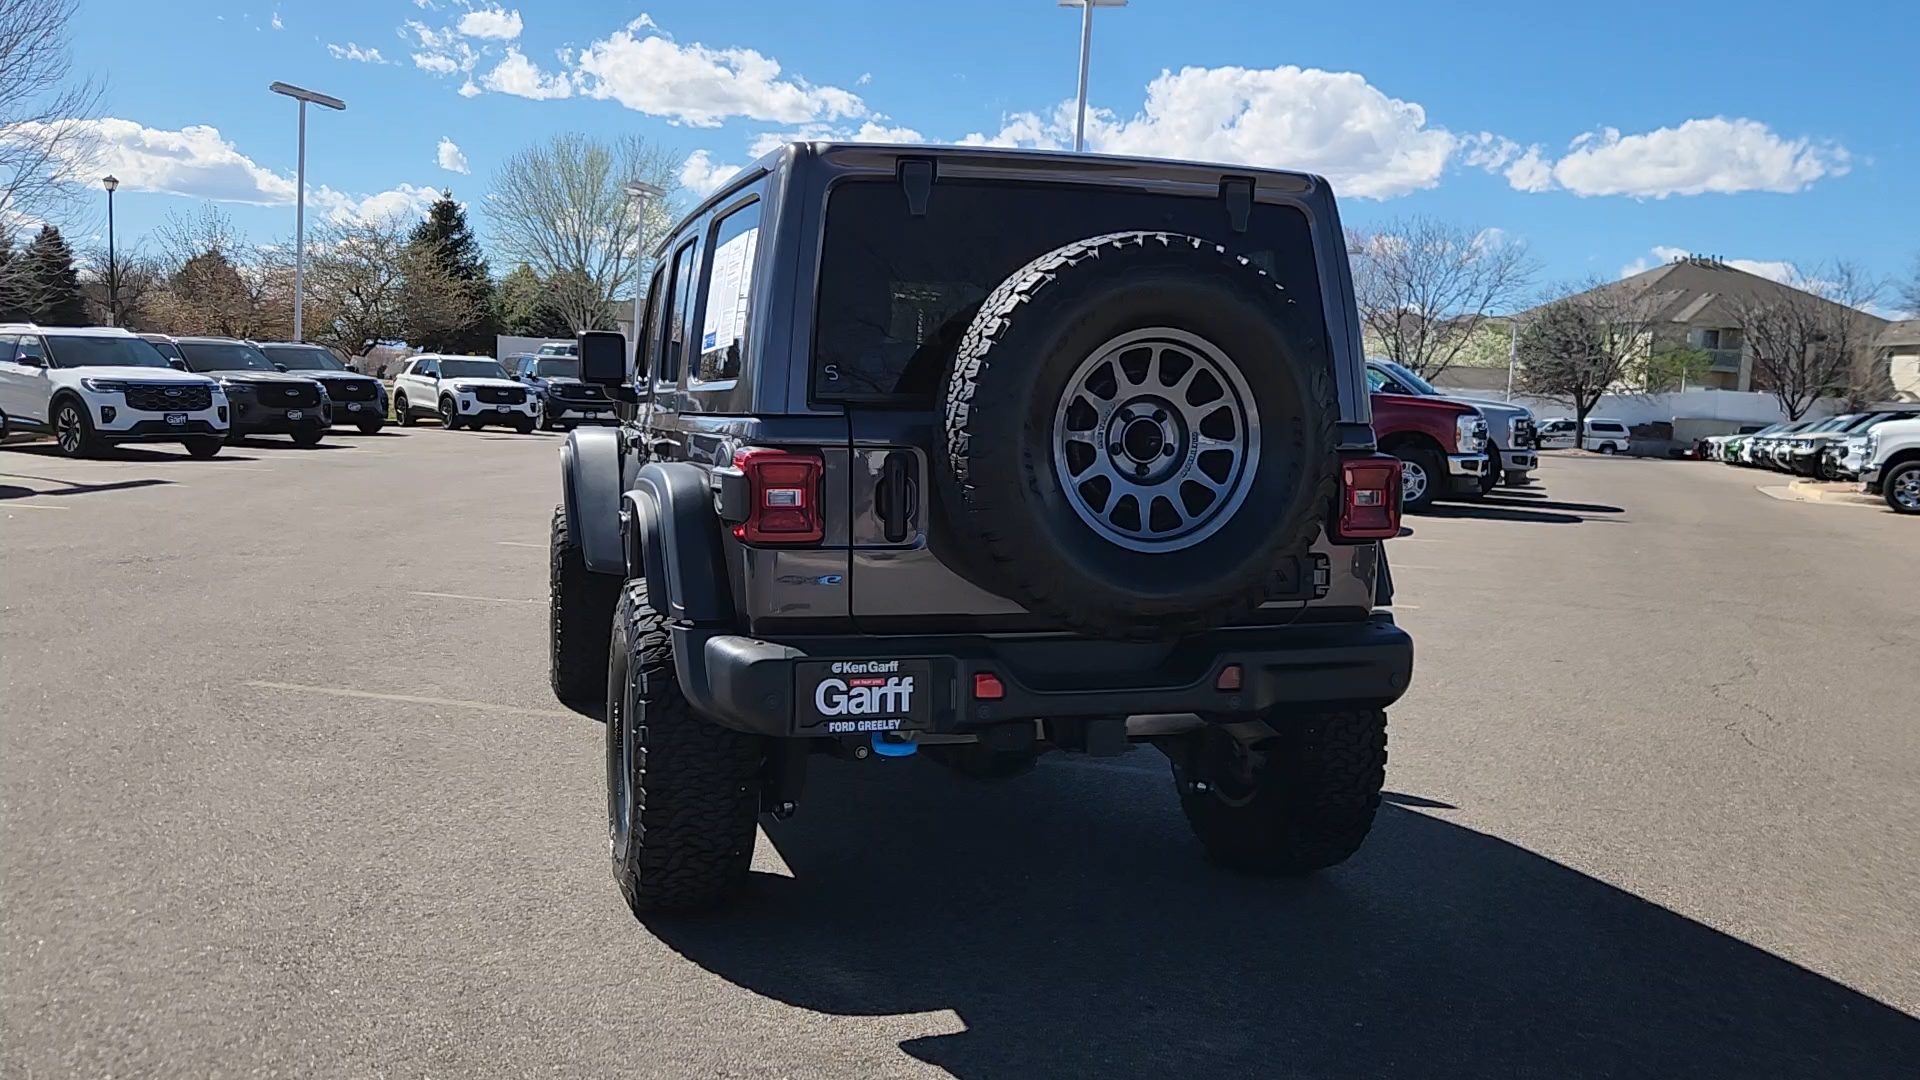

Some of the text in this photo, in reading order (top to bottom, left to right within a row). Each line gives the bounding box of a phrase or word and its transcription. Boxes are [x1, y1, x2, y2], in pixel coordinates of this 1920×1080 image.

[166, 415, 187, 424] Garff
[842, 662, 867, 673] Ken
[868, 661, 899, 673] Garff
[815, 676, 914, 716] Garff
[828, 719, 901, 733] FORD GREELEY
